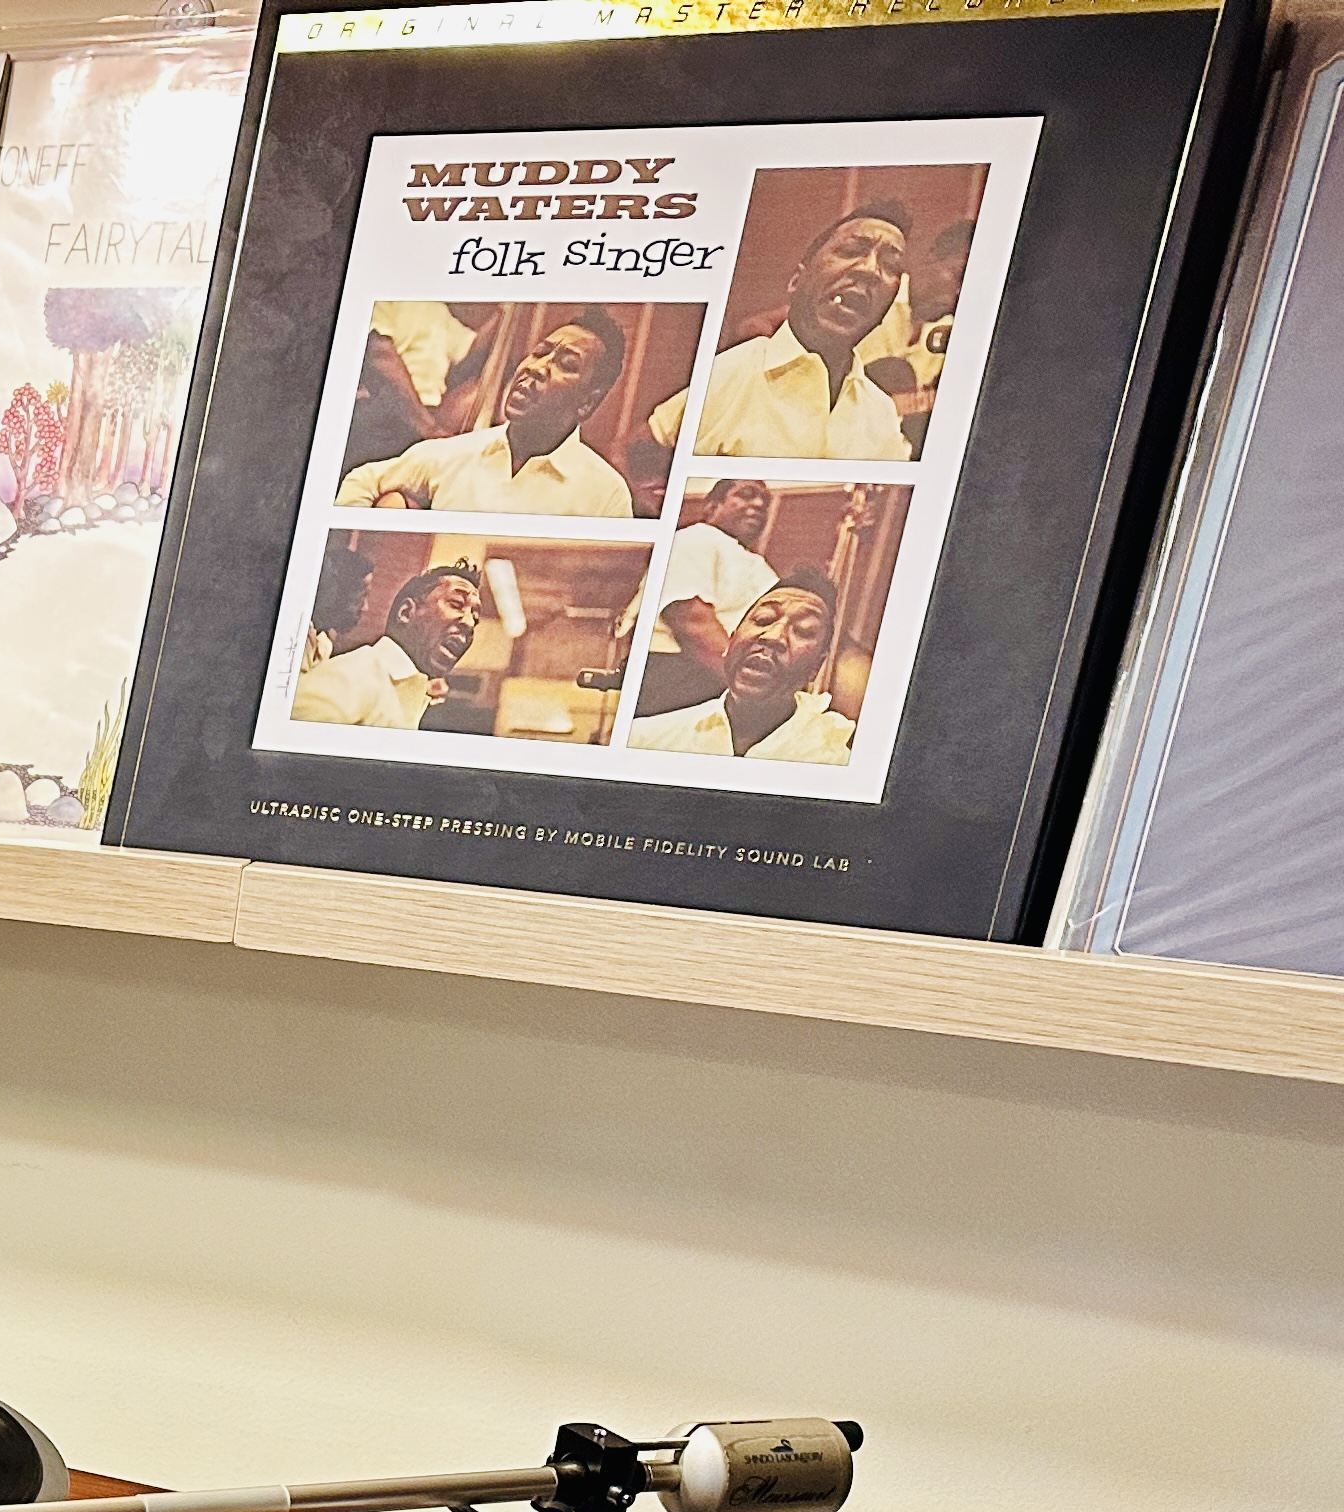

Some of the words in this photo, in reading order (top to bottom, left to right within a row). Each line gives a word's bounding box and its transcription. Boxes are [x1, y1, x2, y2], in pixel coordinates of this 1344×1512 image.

[308, 14, 544, 40] ORIGINAL
[593, 0, 805, 25] MASTER
[407, 157, 675, 188] MUDDY
[402, 193, 699, 222] WATERS
[44, 220, 214, 265] FAIRYTAL
[448, 236, 546, 277] folk
[562, 232, 725, 278] singer
[250, 800, 341, 822] ULTRADISC
[348, 809, 433, 830] ONE-STEP
[440, 818, 527, 840] PRESSING
[534, 828, 558, 842] BY
[564, 830, 635, 850] MOBILE
[642, 838, 728, 860] FIDELITY
[735, 847, 804, 868] SOUND
[813, 855, 850, 872] LAB
